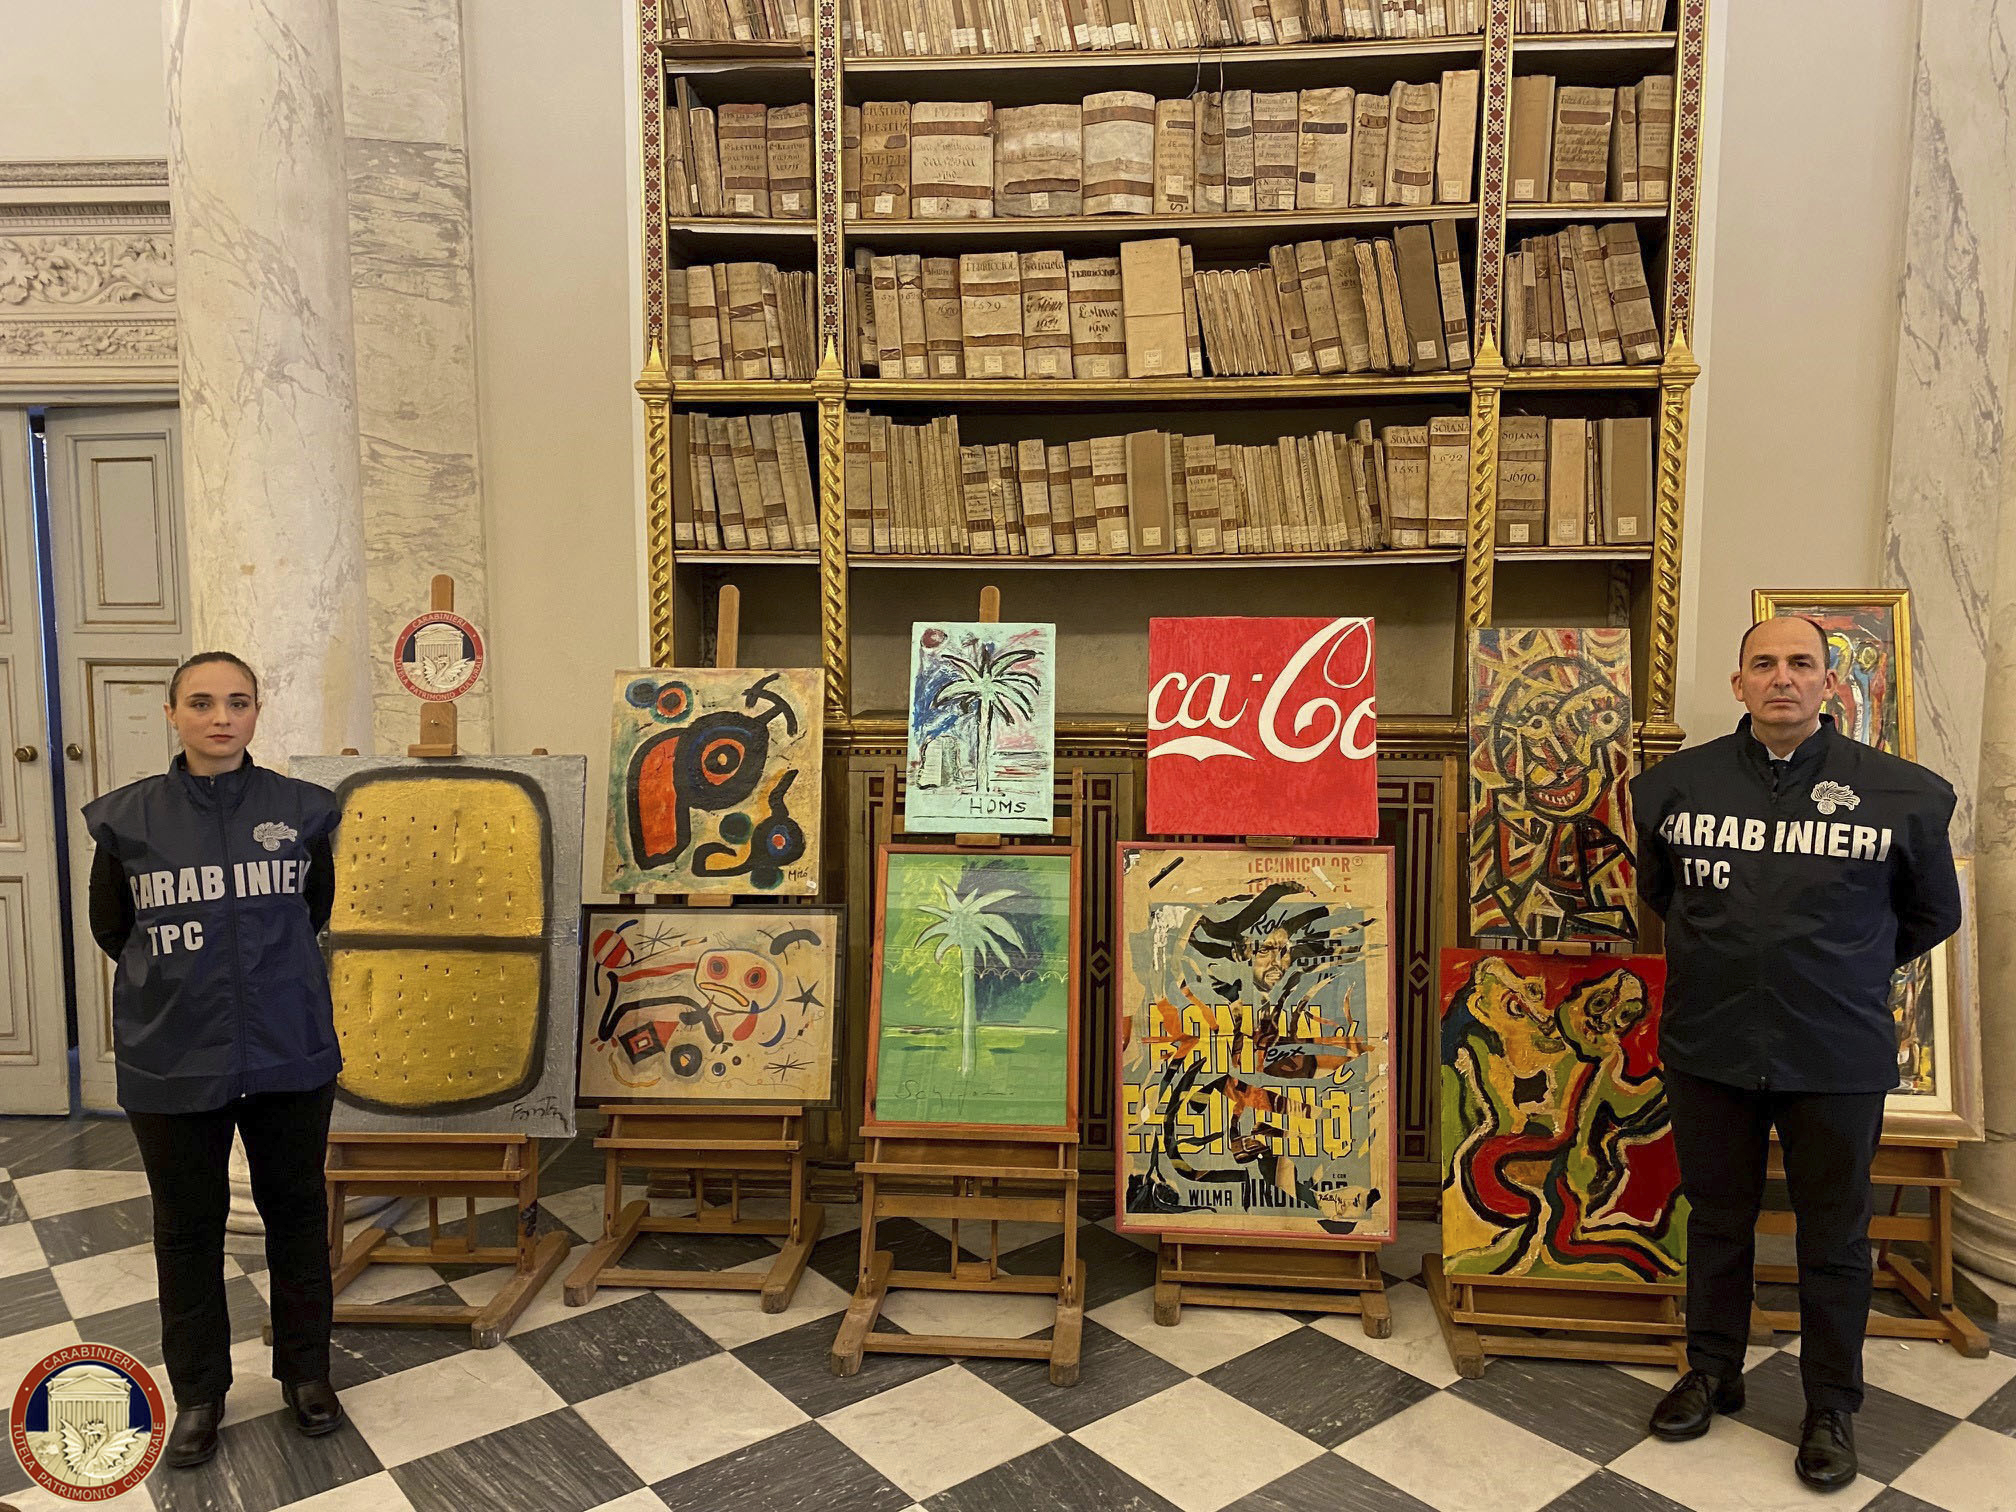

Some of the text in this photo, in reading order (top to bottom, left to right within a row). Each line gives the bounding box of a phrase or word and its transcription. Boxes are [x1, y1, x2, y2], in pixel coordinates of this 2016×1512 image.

[412, 613, 466, 628] CARABINIERI
[395, 656, 483, 700] TUTELA PATRIMONIO CULTURALE
[969, 797, 1027, 815] HOMS
[1681, 857, 1731, 890] TPC
[147, 920, 204, 956] TPC
[1188, 1189, 1233, 1207] WILMA
